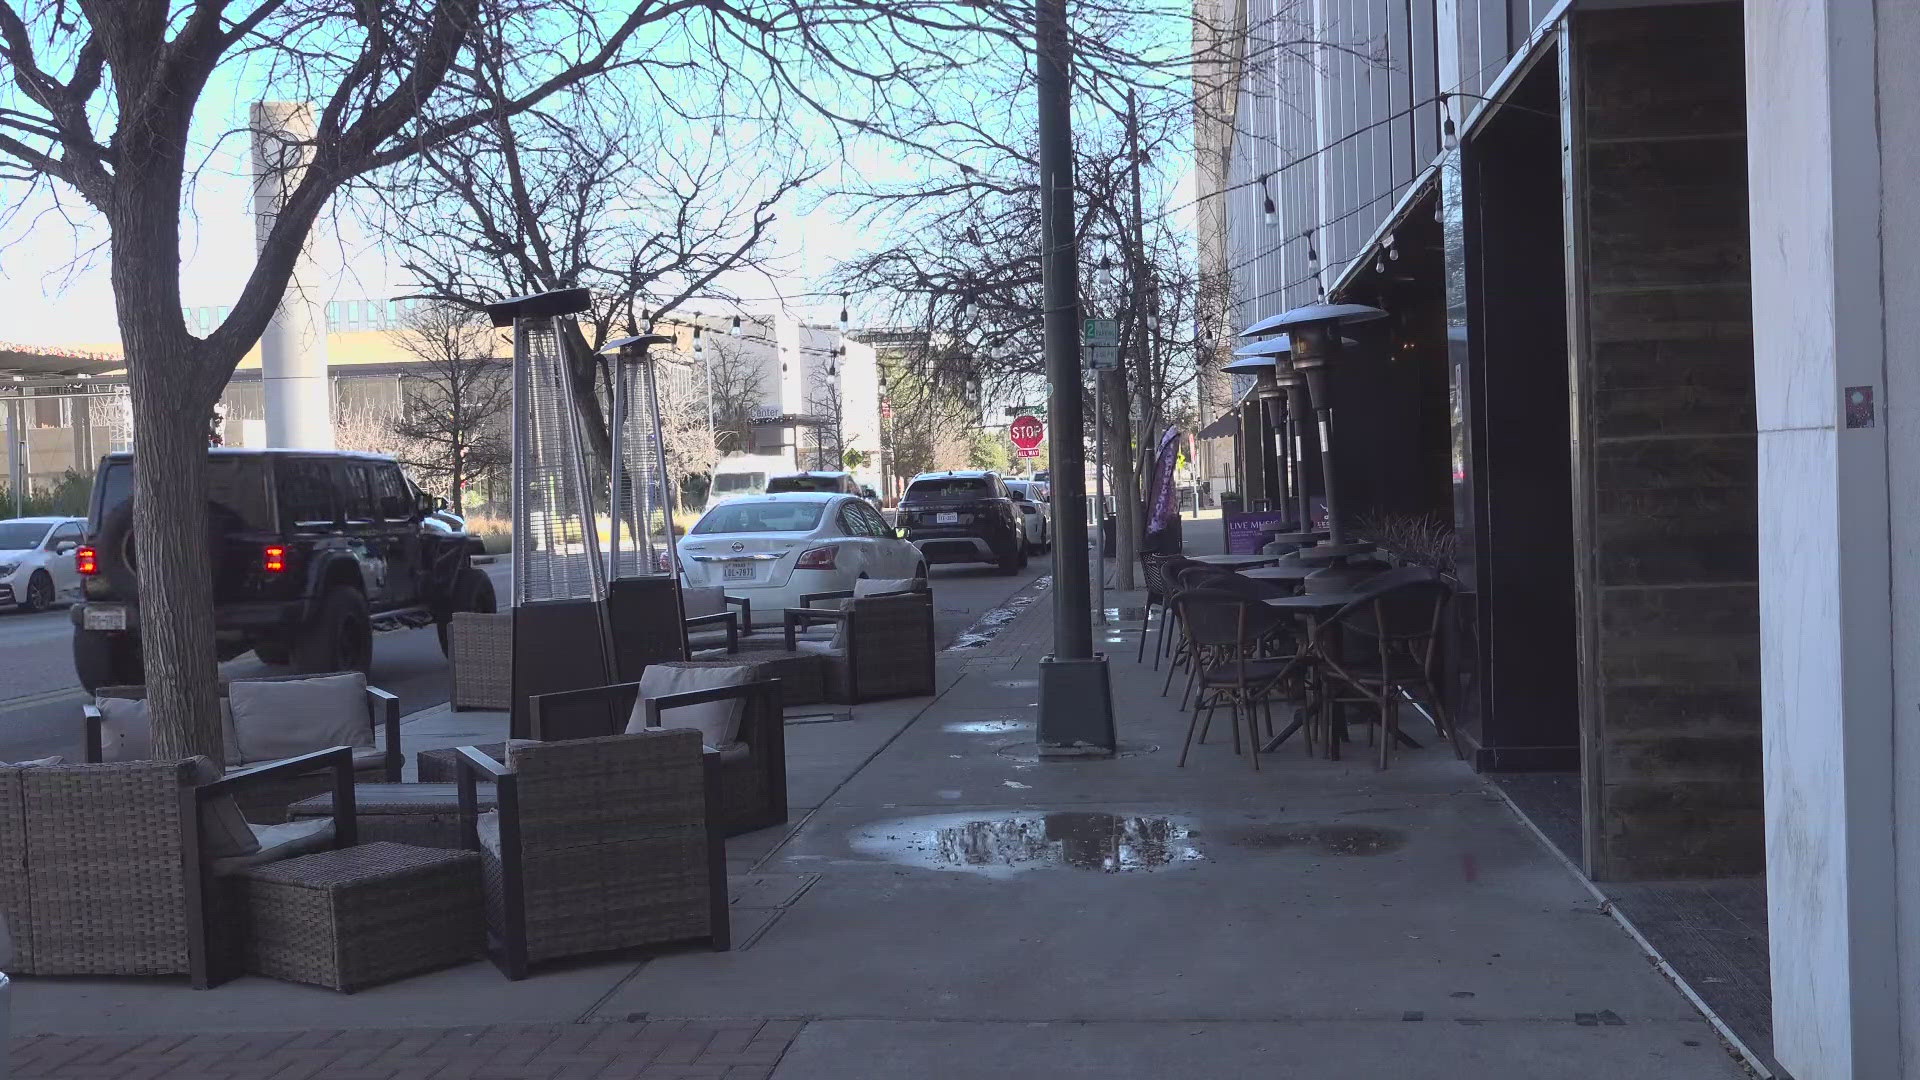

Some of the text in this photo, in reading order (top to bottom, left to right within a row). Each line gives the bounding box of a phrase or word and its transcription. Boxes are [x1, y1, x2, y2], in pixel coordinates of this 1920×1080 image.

[1087, 323, 1094, 337] 2
[751, 408, 779, 418] Center
[1012, 425, 1041, 439] STOP
[1230, 521, 1248, 530] LIVE
